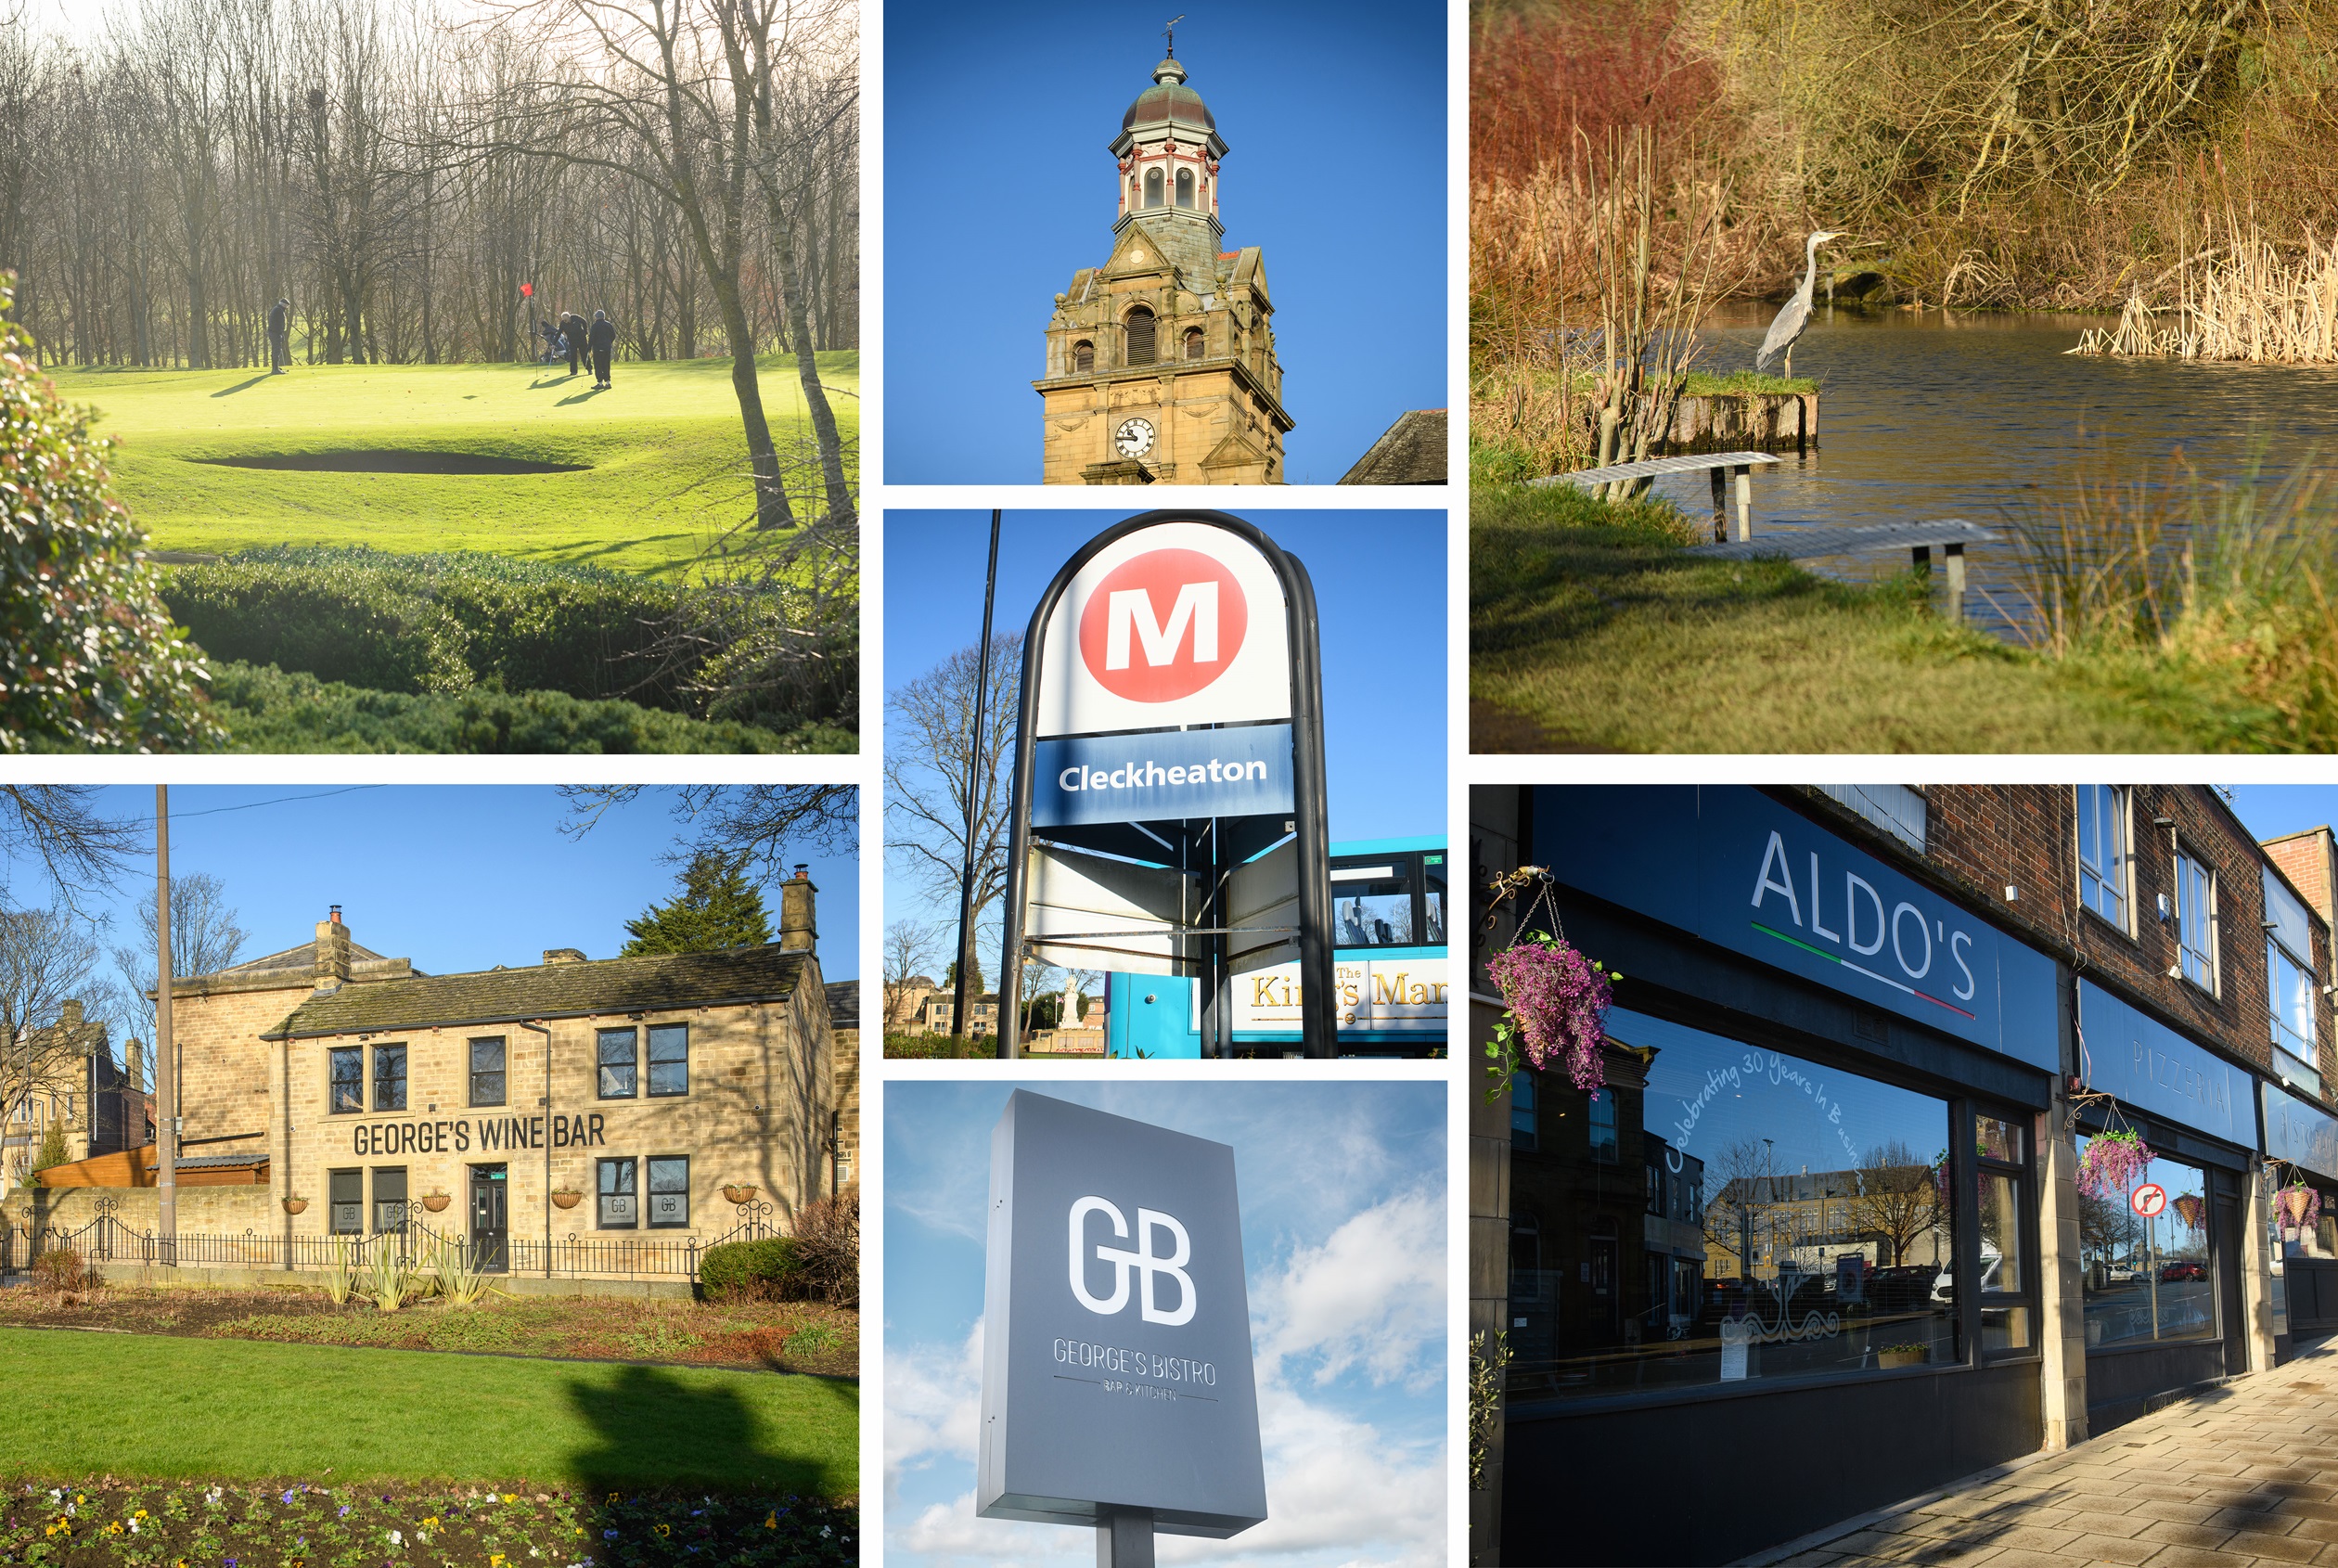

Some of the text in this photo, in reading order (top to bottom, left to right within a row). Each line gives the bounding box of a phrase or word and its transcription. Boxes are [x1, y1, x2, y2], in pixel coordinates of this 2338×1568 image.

[1106, 581, 1218, 671] M
[1058, 759, 1267, 792] Cleckheaton
[1750, 829, 1975, 1001] ALDO'S
[1336, 967, 1361, 979] The
[1251, 975, 1359, 1012] Ki's
[2133, 1039, 2225, 1114] PIZZERIA
[1666, 1065, 1741, 1174] Celebrating
[1742, 1051, 1764, 1074] 30
[1769, 1051, 1813, 1095] Years
[353, 1113, 606, 1156] GEORGE'S WINE BAR
[343, 1207, 355, 1220] GB
[611, 1199, 626, 1213] GB
[662, 1197, 676, 1212] GB
[1069, 1194, 1198, 1327] GB
[1054, 1337, 1216, 1386] GEORGE'S BISTRO
[1103, 1378, 1177, 1402] BAR & KITCHEN
